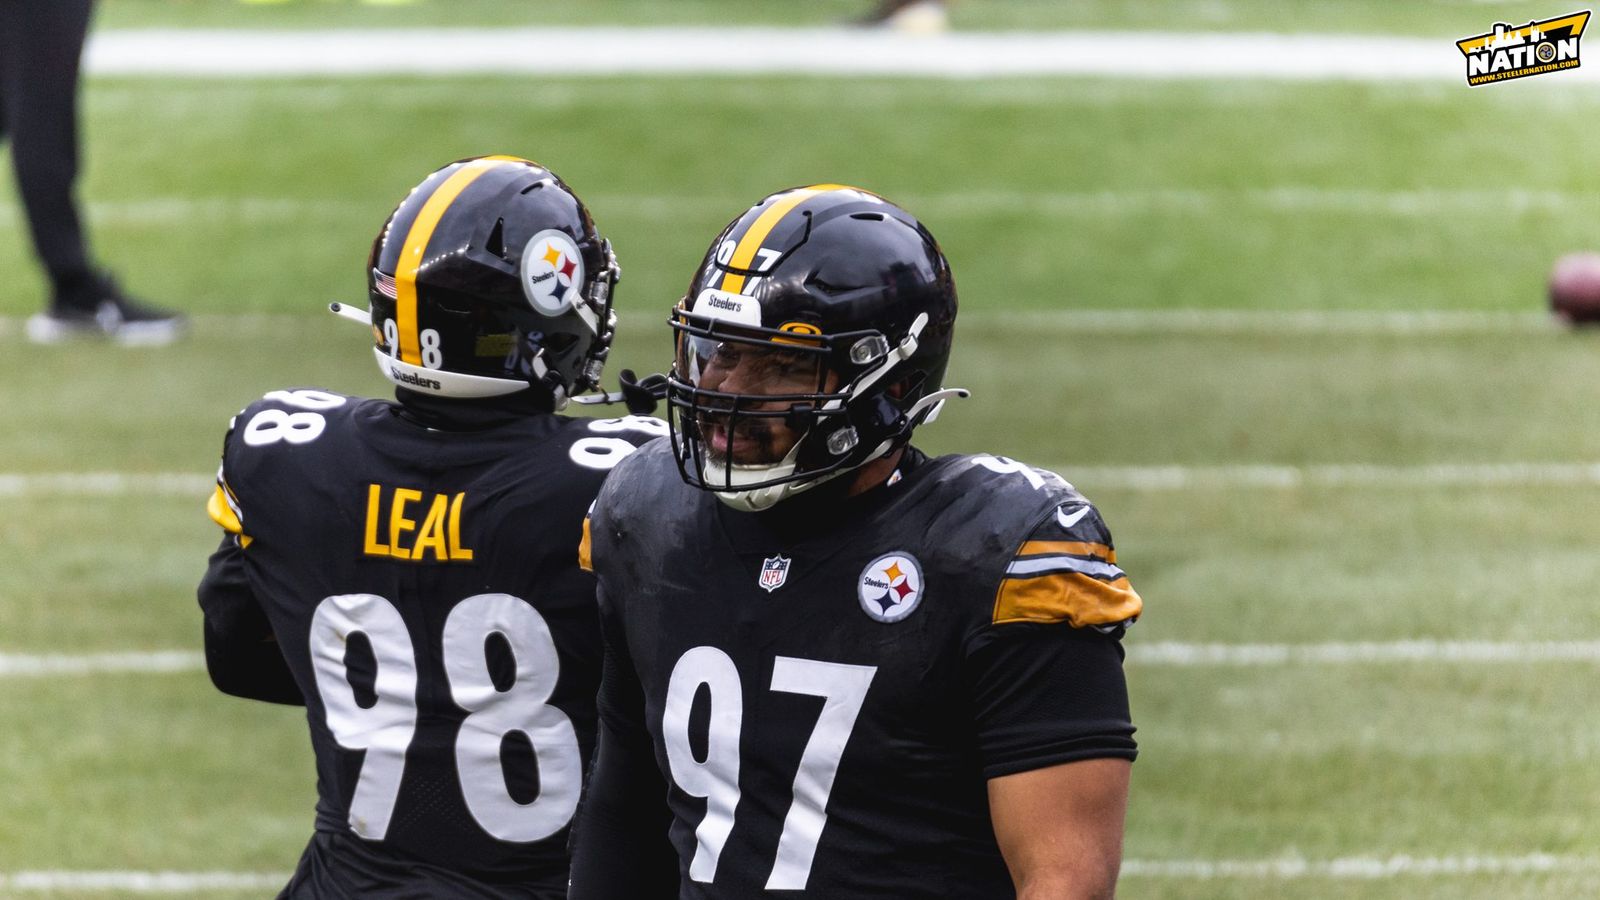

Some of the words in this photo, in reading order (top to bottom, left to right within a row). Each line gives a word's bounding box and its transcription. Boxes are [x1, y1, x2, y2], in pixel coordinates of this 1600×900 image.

[708, 294, 742, 312] Steelers
[384, 318, 442, 370] 98
[391, 366, 441, 390] Steelers
[364, 483, 474, 562] LEAL
[764, 570, 781, 584] NFL
[864, 577, 889, 590] Steelers
[309, 593, 583, 843] 98
[663, 646, 878, 891] 97
